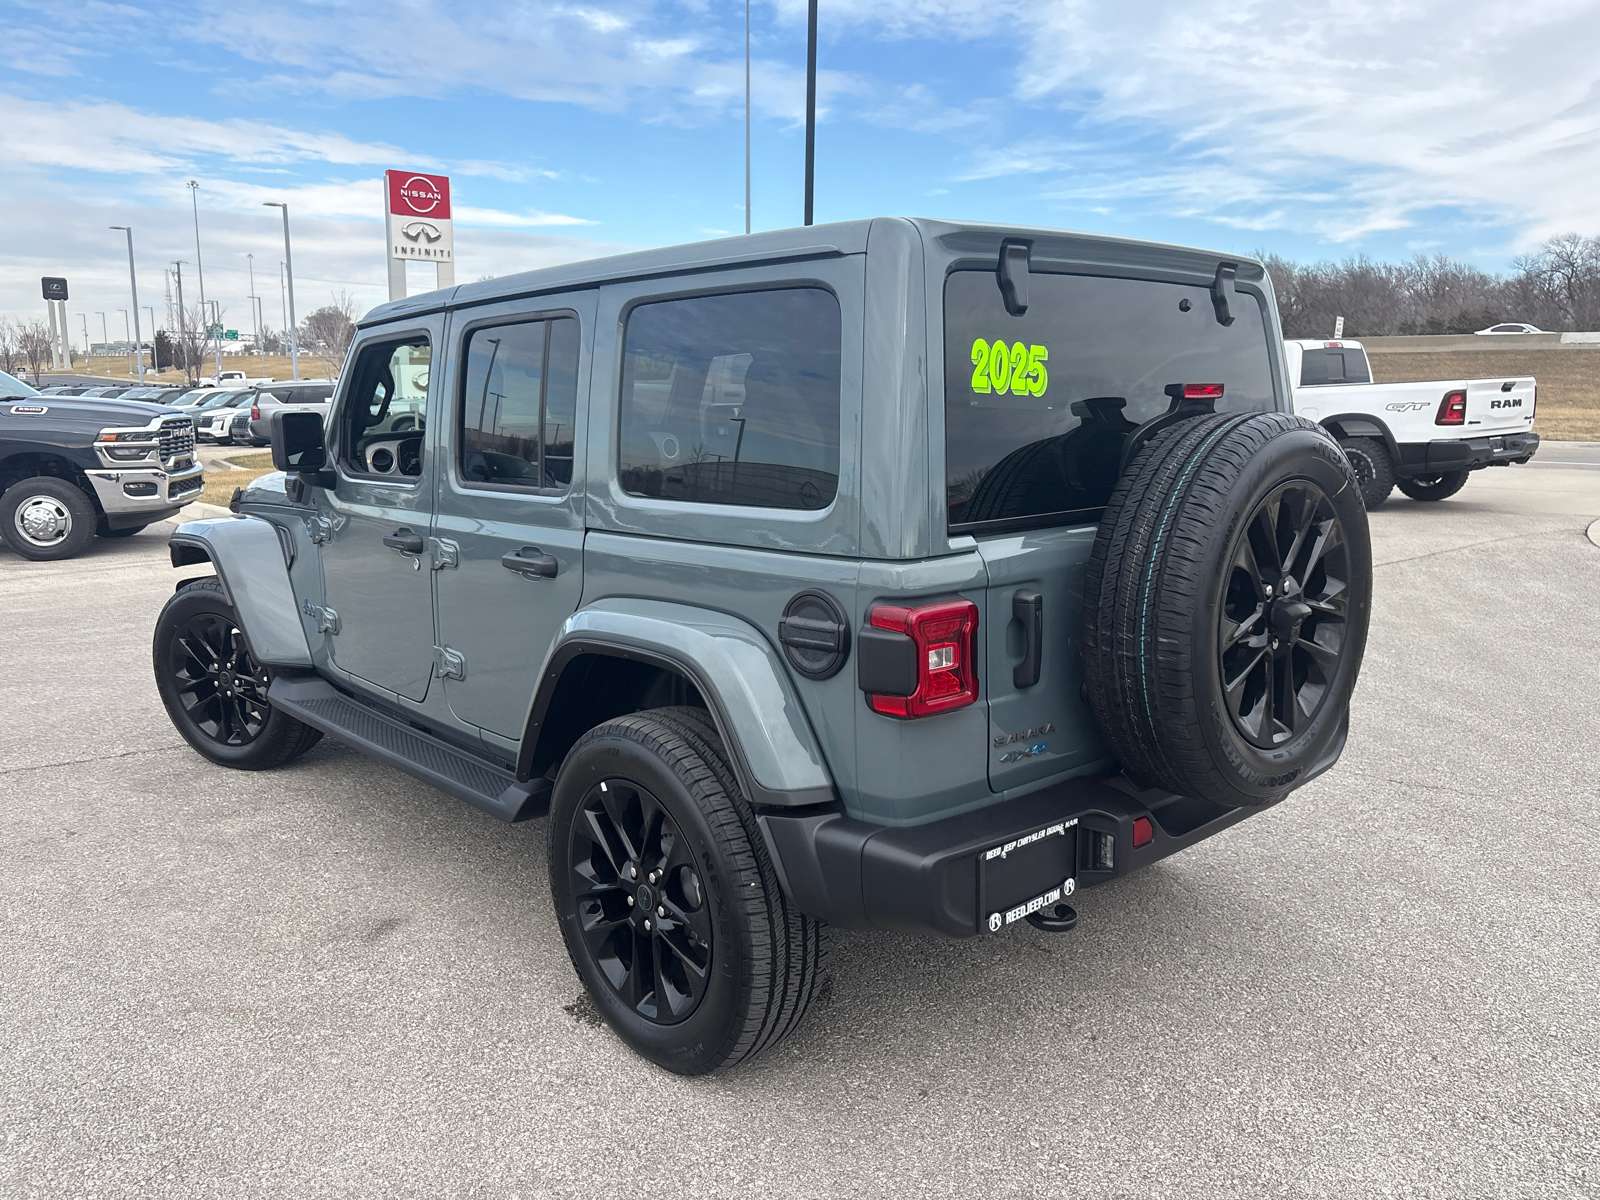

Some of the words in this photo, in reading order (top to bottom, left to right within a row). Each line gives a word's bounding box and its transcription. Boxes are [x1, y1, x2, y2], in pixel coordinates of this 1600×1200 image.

[400, 189, 441, 200] NISSAN
[395, 245, 451, 257] INFINITI
[971, 338, 1048, 397] 2025
[1490, 398, 1522, 409] RAM
[994, 723, 1055, 748] SAHARA
[986, 847, 1001, 860] REED
[1003, 841, 1017, 853] JEEP
[1017, 829, 1046, 847] CHRYSLER
[1046, 823, 1064, 836] DODGE
[1065, 818, 1079, 828] RAM
[702, 851, 733, 957] NEXEN
[1006, 888, 1060, 925] REEDJEEP.COM
